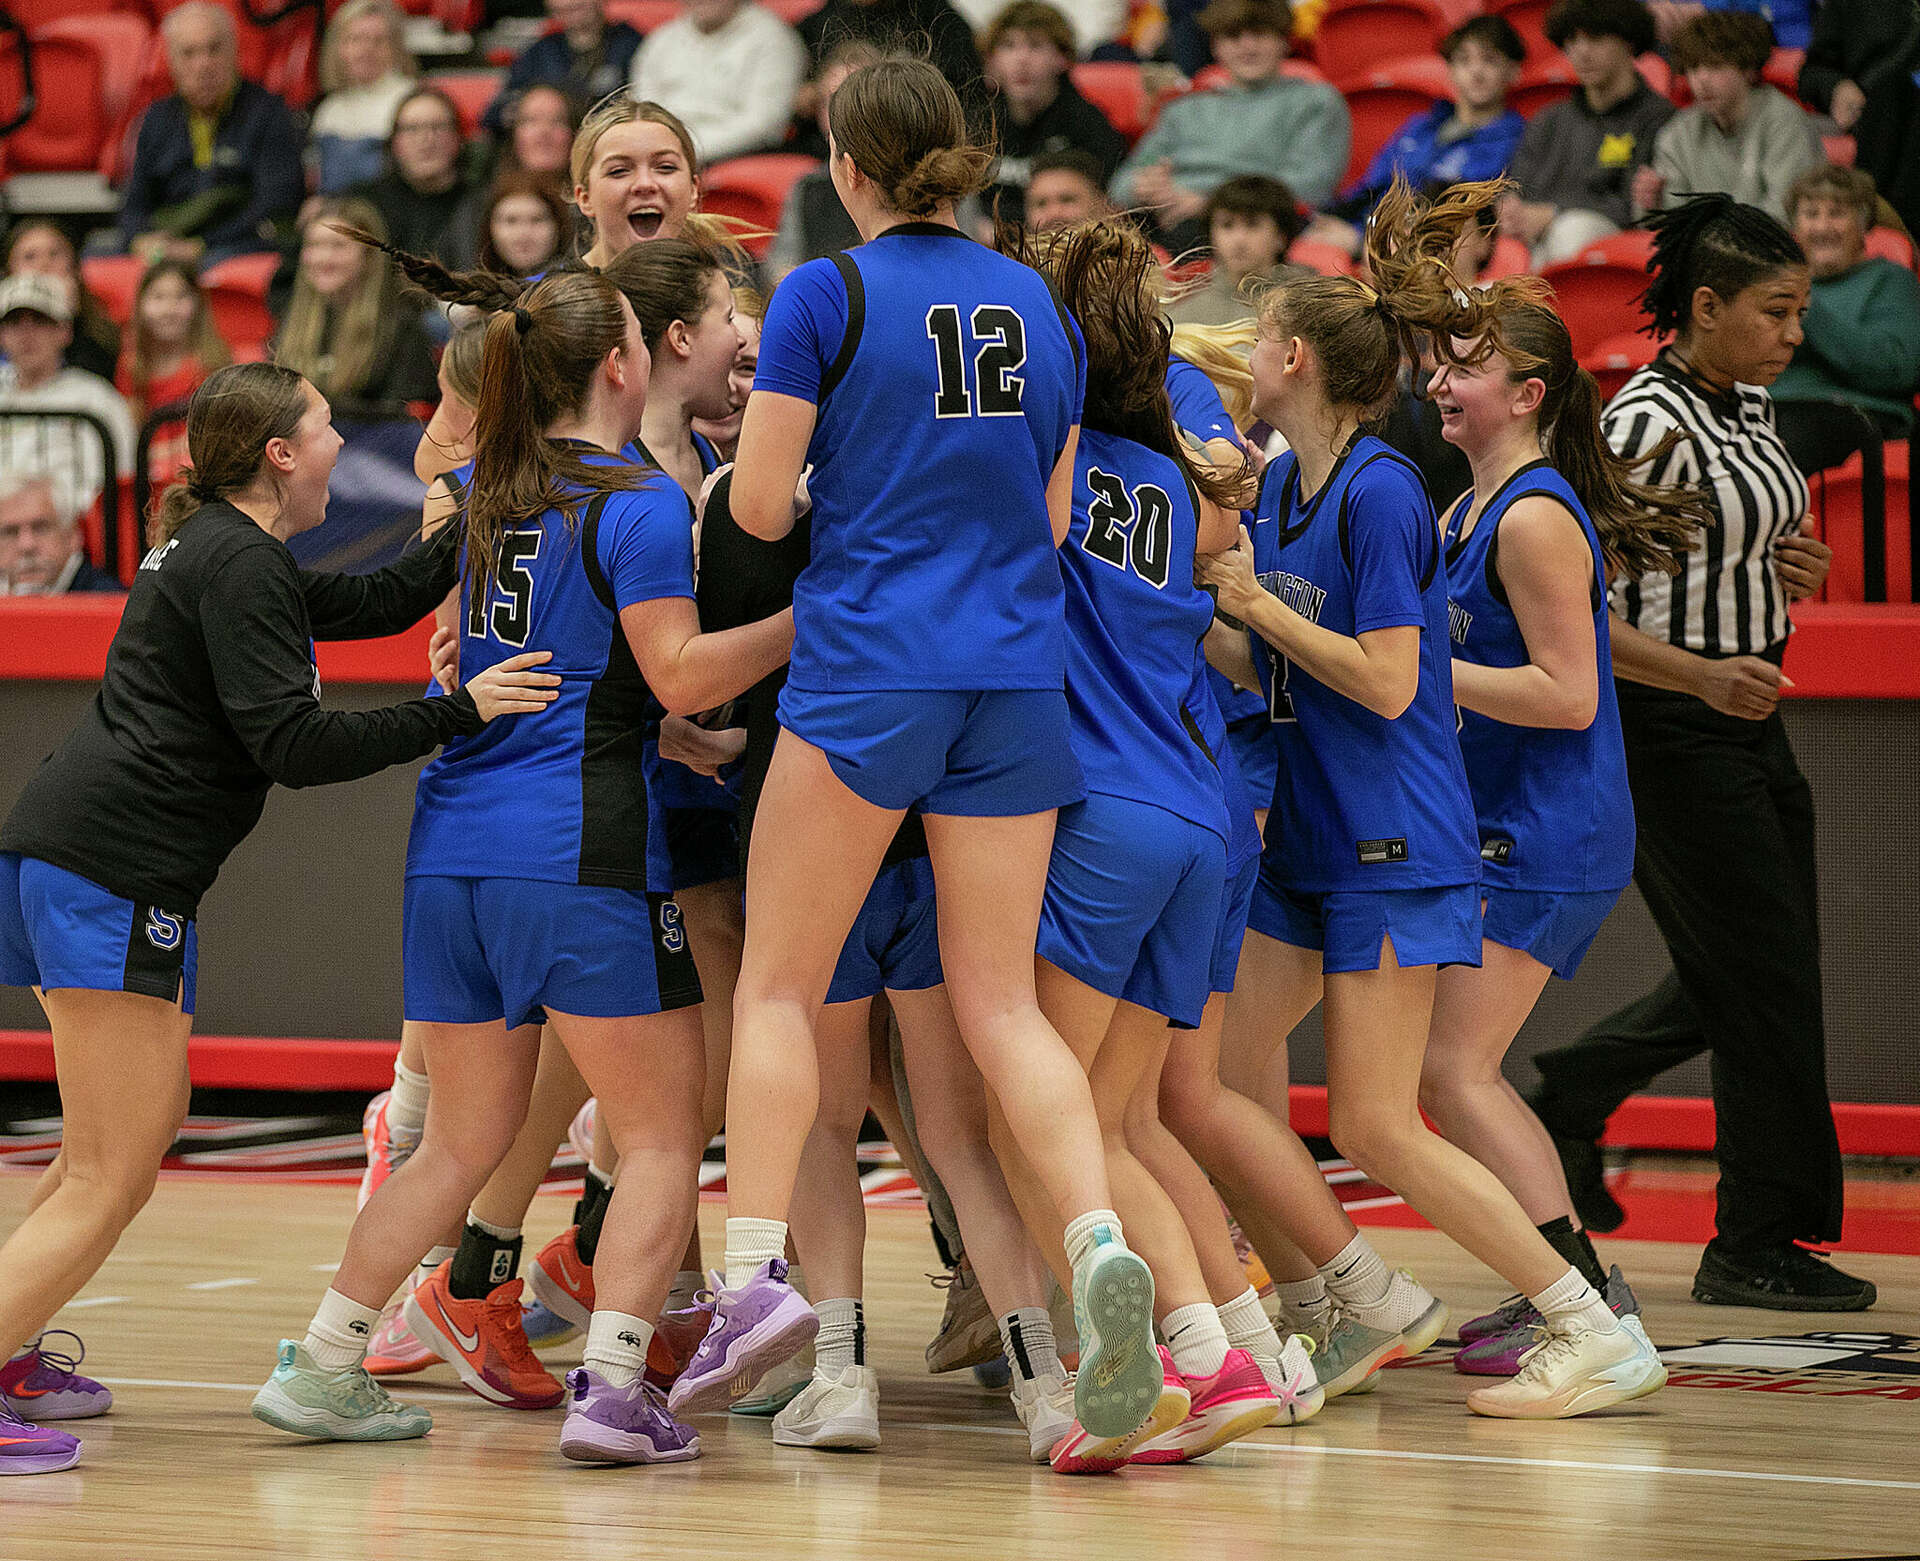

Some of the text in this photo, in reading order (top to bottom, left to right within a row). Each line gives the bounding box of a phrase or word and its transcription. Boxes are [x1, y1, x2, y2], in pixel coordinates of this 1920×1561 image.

[924, 303, 1028, 419] 12
[1081, 465, 1174, 590] 20
[1392, 844, 1402, 855] M
[145, 905, 185, 952] S
[660, 901, 684, 954] S
[1666, 1371, 1920, 1400] GLA
